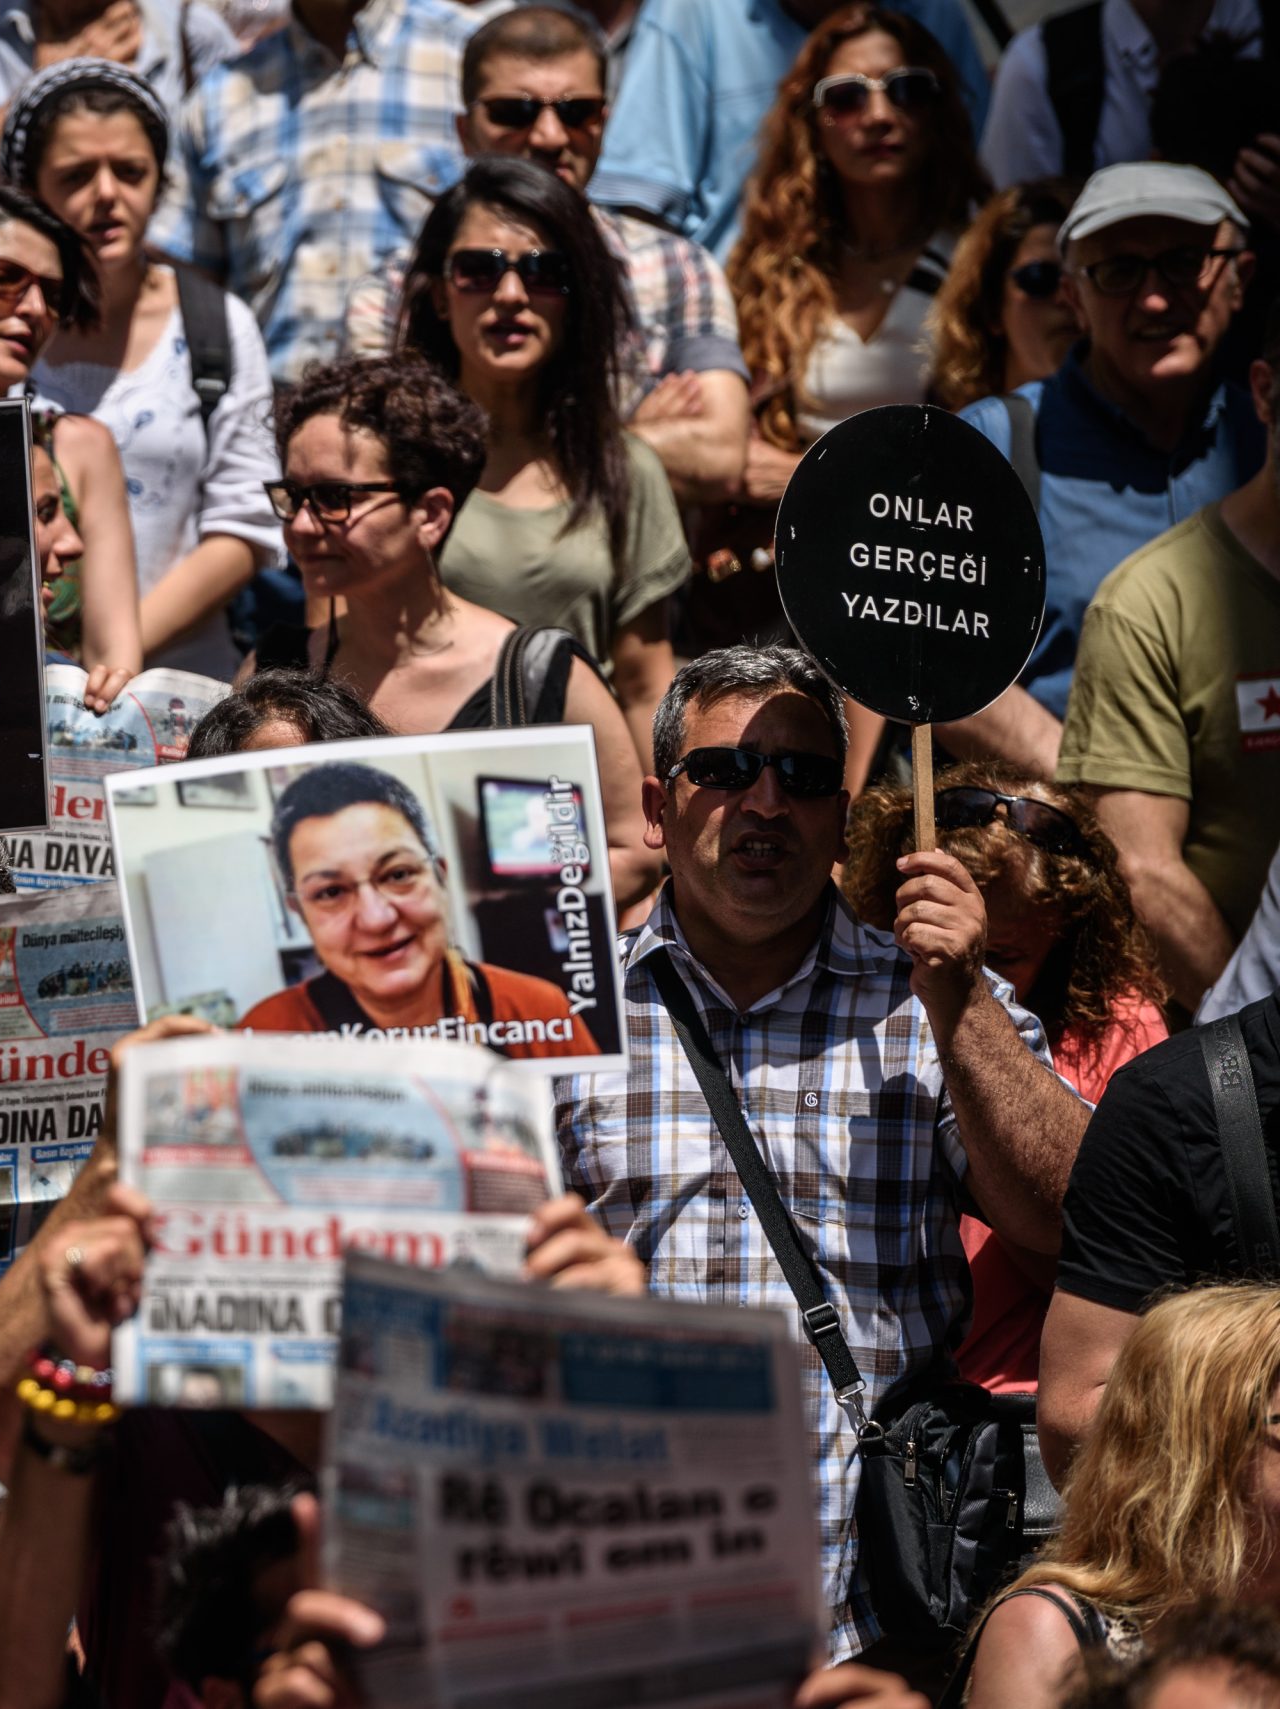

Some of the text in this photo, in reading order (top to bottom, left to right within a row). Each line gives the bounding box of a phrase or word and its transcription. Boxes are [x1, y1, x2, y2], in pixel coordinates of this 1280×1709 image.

[869, 493, 974, 532] ONLAR
[850, 542, 987, 586] GERÇEĞİ
[841, 592, 990, 639] YAZDILAR
[22, 925, 126, 949] Dünya mültecileşiy
